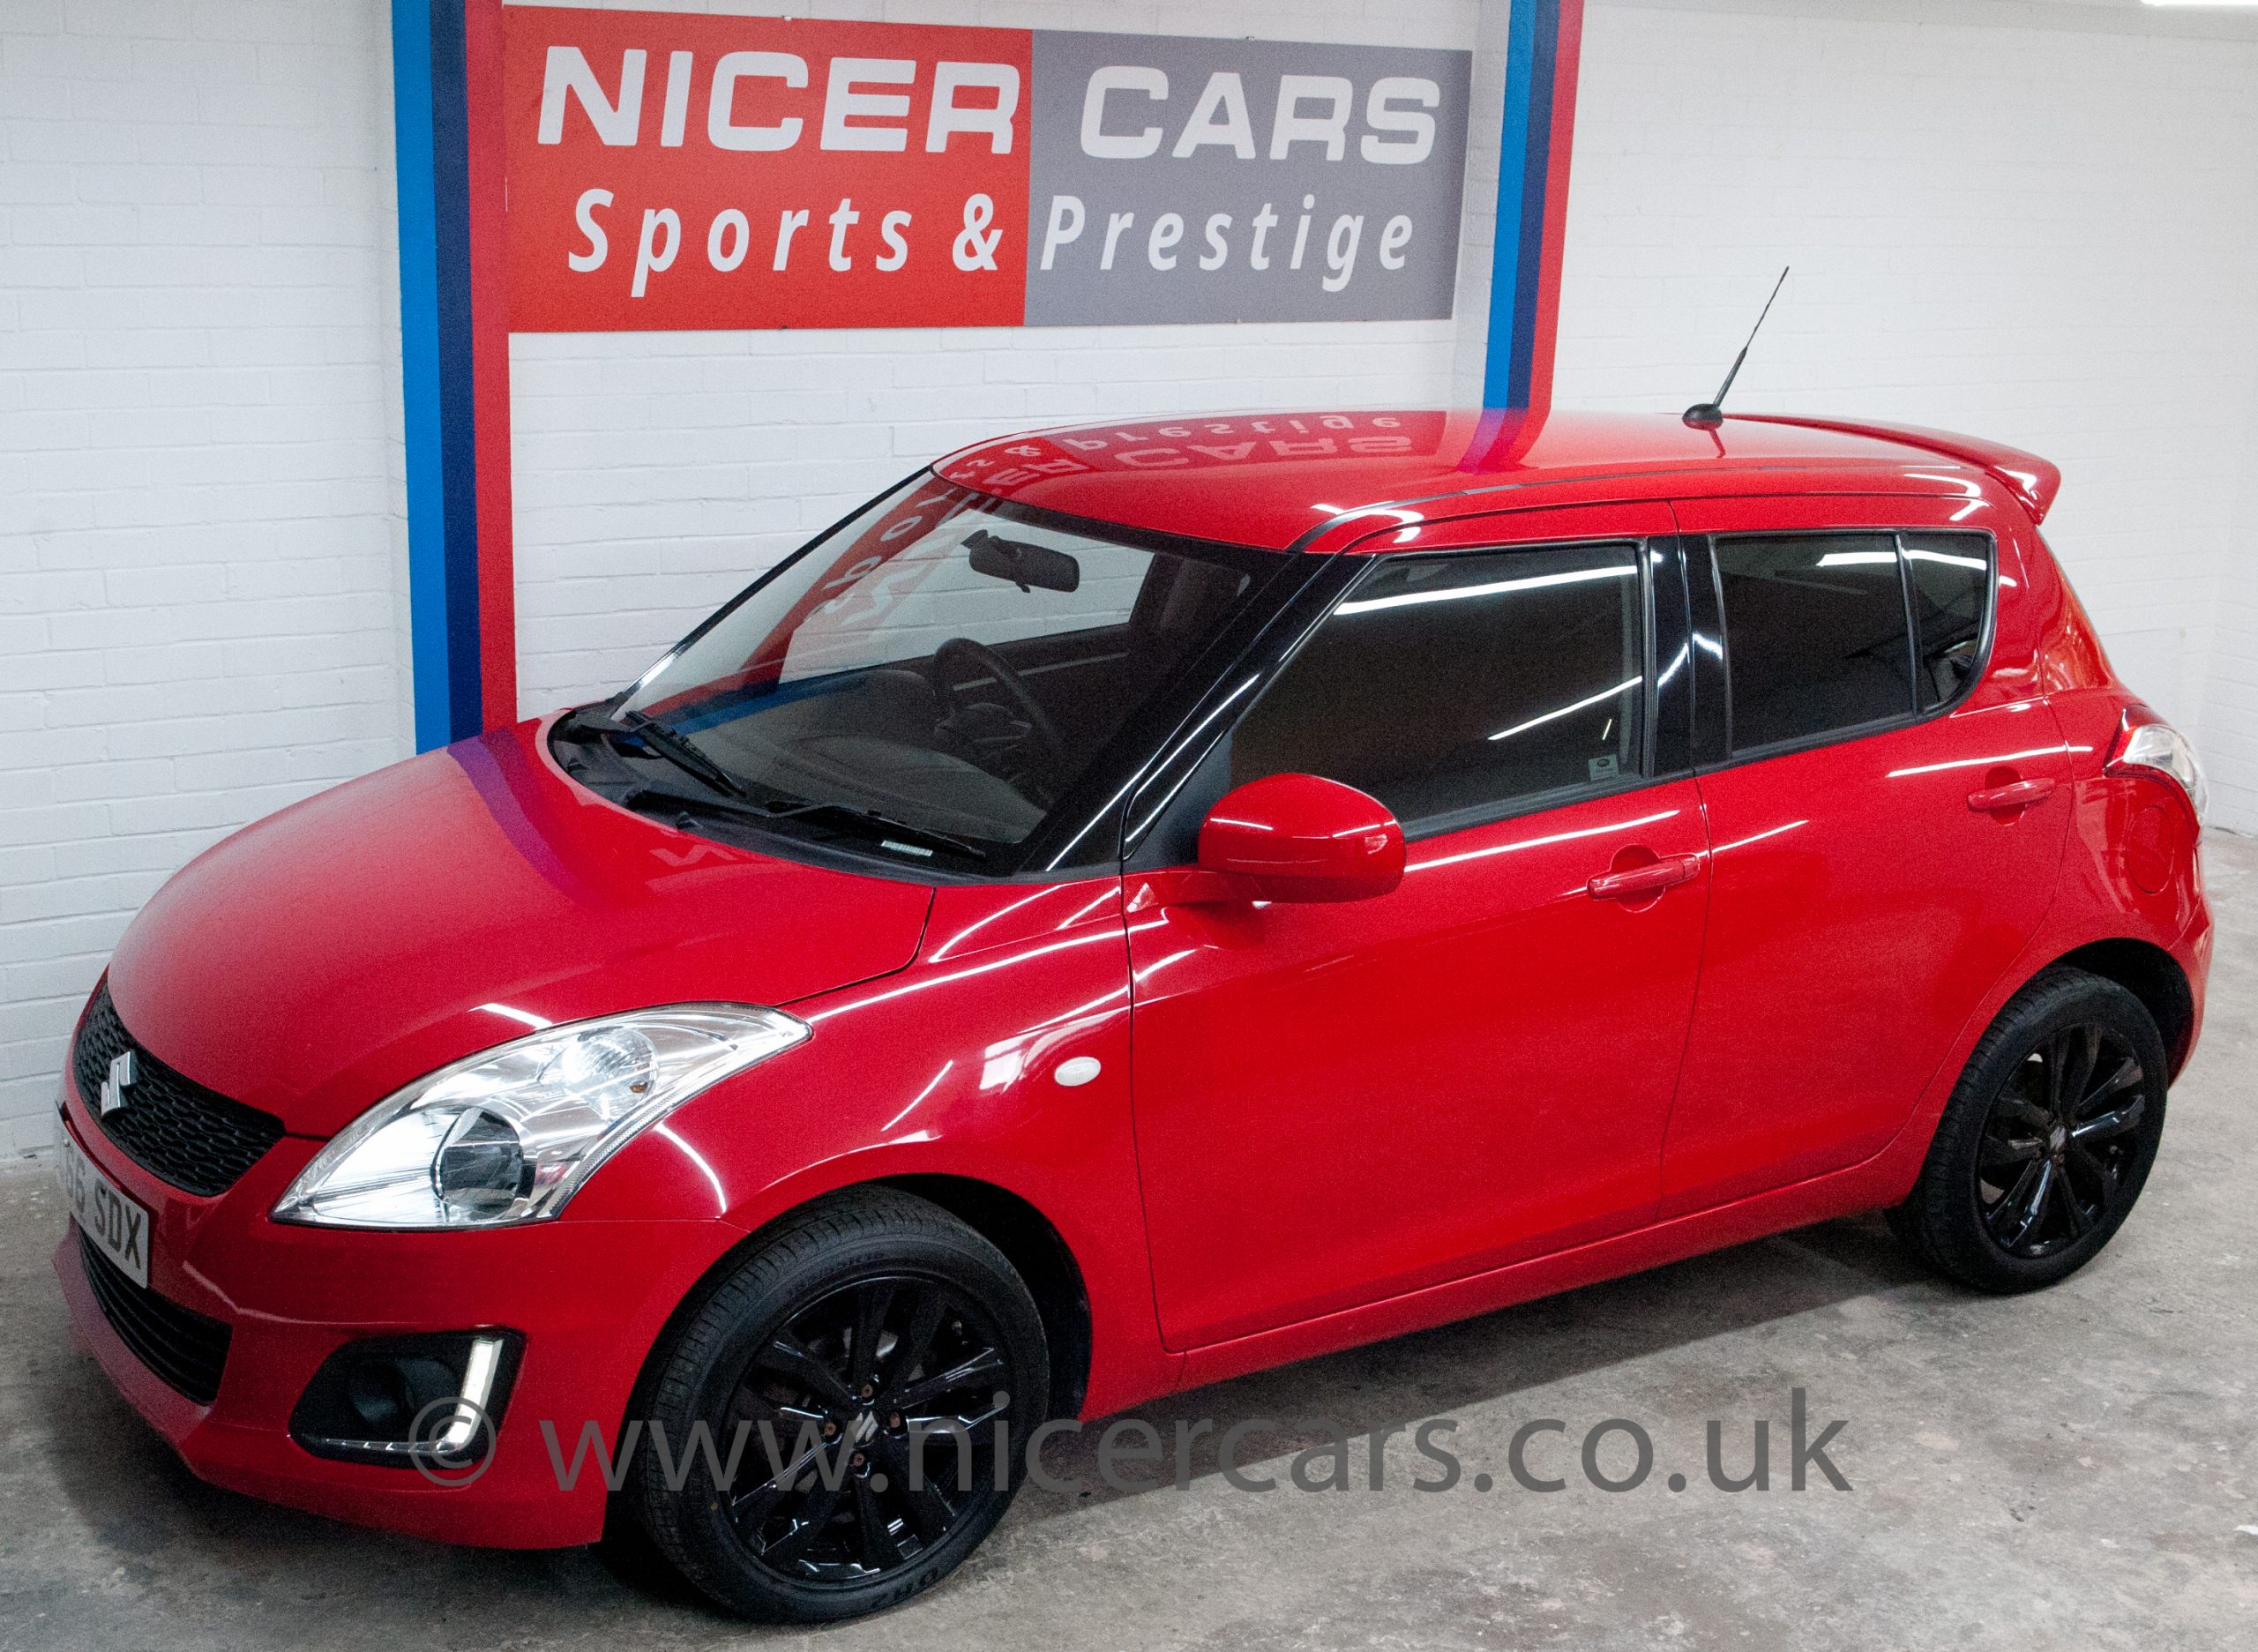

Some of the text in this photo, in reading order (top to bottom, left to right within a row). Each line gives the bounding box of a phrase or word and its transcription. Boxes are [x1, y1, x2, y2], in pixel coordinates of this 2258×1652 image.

[537, 45, 1441, 165] NICER CARS
[567, 188, 1414, 297] Sports & Prestige
[93, 1177, 142, 1271] SDX
